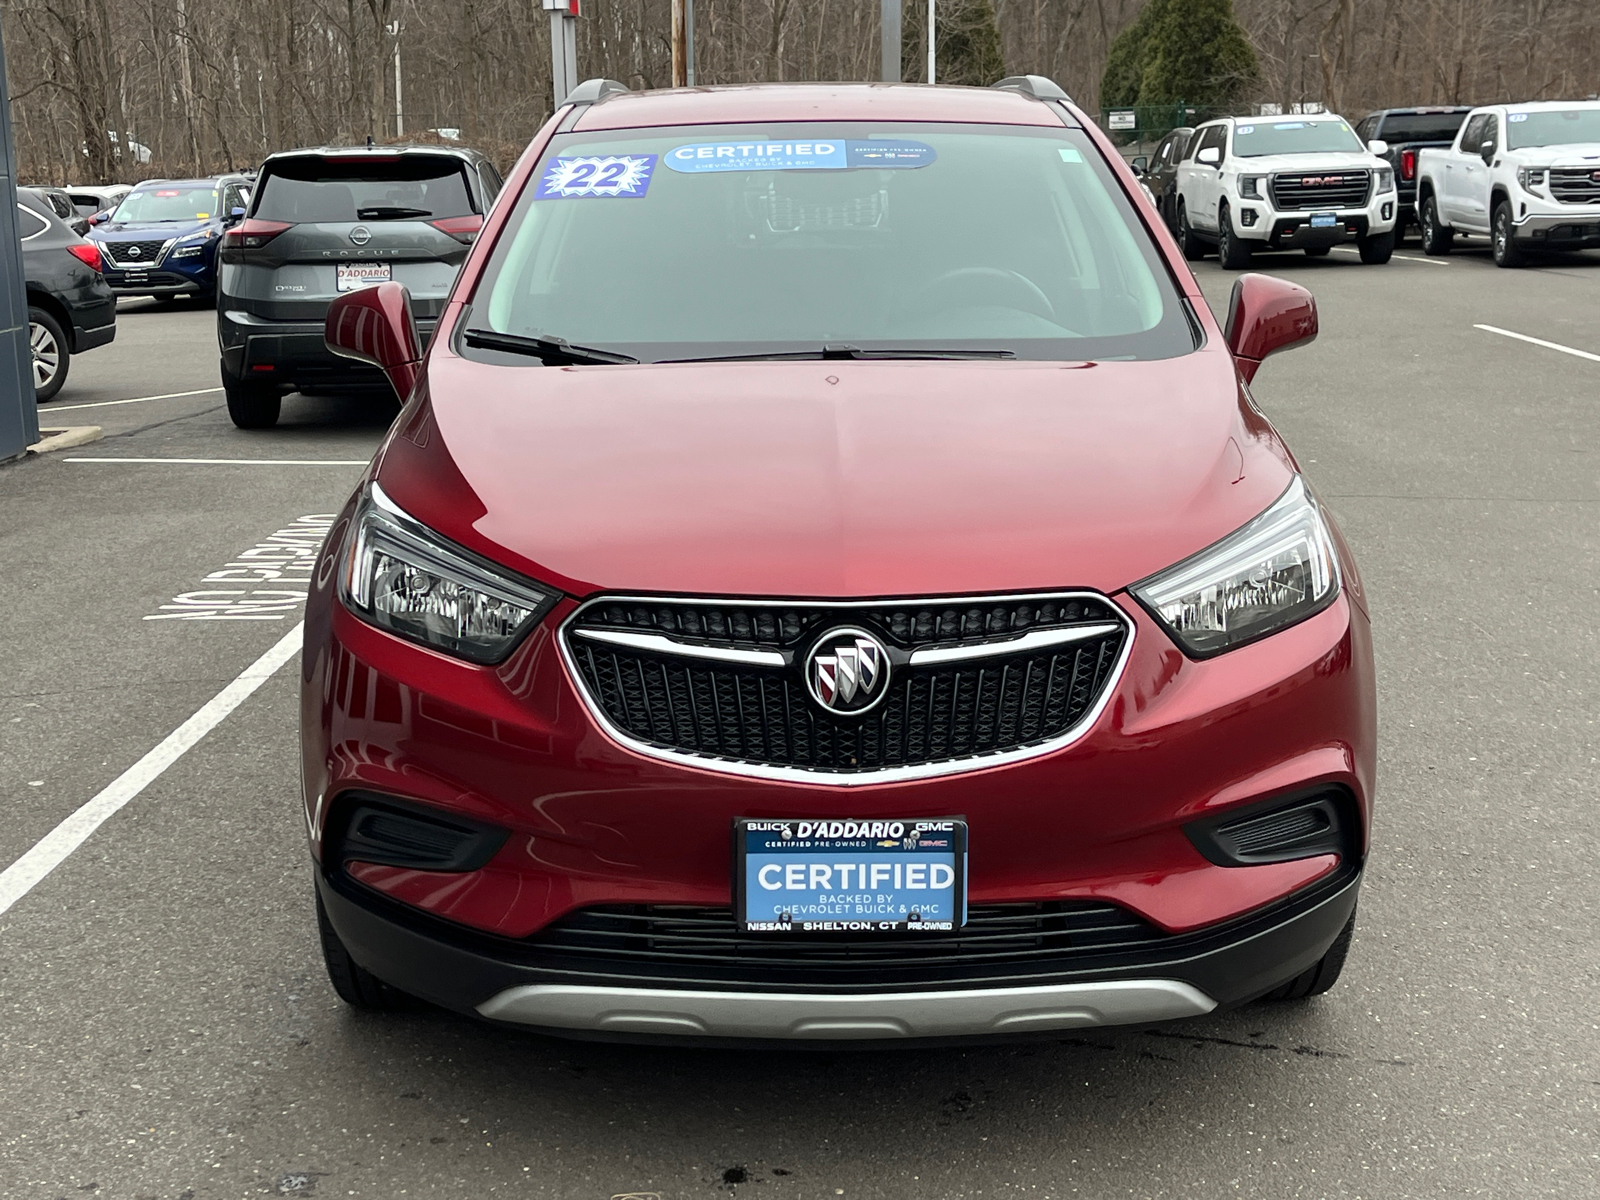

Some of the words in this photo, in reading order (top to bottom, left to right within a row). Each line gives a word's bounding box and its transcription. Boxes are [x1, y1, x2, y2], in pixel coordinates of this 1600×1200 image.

[674, 143, 836, 160] CERTIFIED
[695, 161, 750, 169] CHEVROLET
[563, 163, 627, 188] 22
[1302, 176, 1343, 187] GMC
[338, 269, 390, 278] D'ADDARIO
[747, 823, 791, 831] BUICK
[797, 822, 904, 838] D'ADDARIO
[915, 823, 954, 831] GMC
[758, 863, 955, 891] CERTIFIED
[819, 895, 872, 904] BACKED
[877, 895, 894, 904] BY
[773, 905, 850, 914] CHEVROLET
[855, 904, 895, 914] BUICK
[899, 904, 907, 914] &
[911, 904, 939, 914] GMC
[747, 922, 792, 931] NISSAN
[803, 922, 875, 931] SHELTON,
[879, 921, 899, 930] CT
[907, 922, 953, 930] PRE-OWNED
